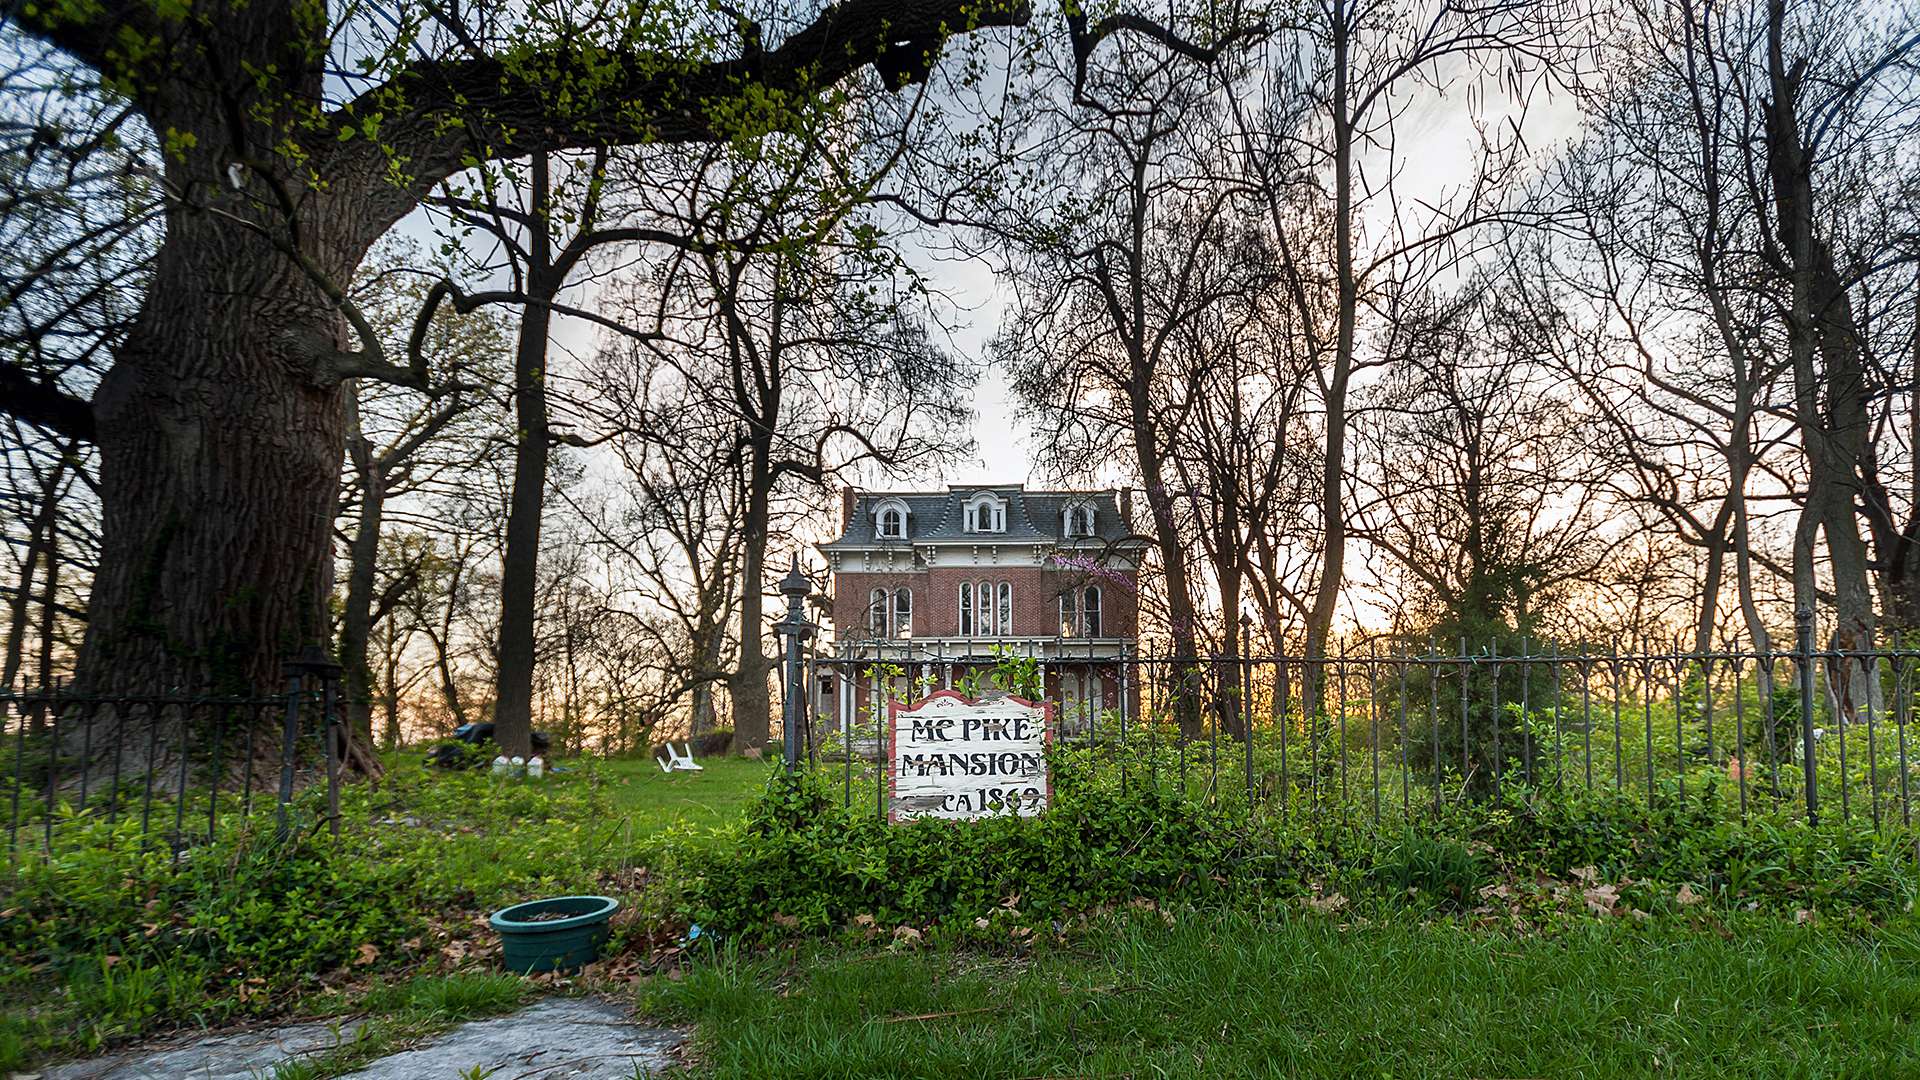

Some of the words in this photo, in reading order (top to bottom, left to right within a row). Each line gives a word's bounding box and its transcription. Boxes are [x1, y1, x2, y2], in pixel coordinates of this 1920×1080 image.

[911, 719, 955, 742] MC
[962, 719, 1031, 741] PIKE
[902, 753, 1040, 776] MANSION
[976, 788, 1040, 812] 1869
